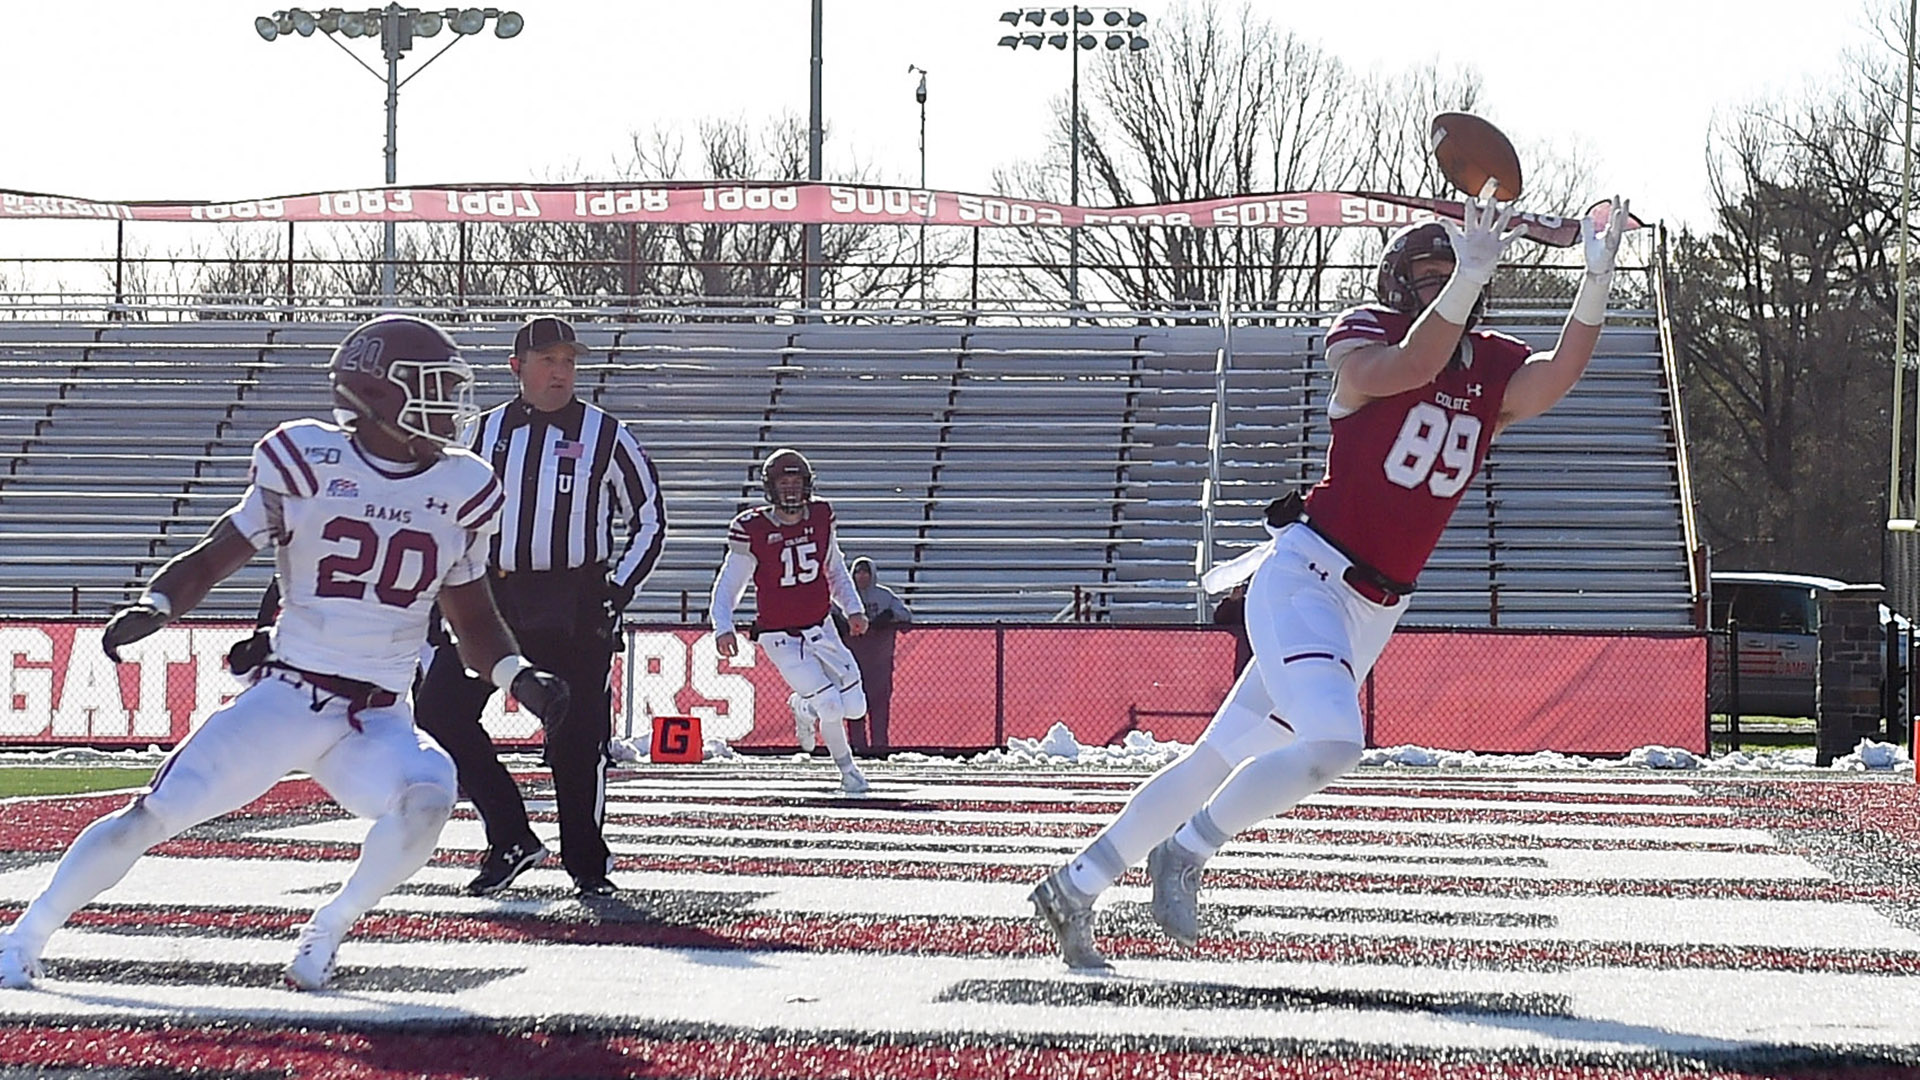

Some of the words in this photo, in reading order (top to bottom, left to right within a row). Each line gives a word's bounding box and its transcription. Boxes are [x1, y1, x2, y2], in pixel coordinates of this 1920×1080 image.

[342, 335, 384, 373] 20
[1384, 401, 1482, 498] 89
[558, 473, 573, 493] U
[364, 504, 412, 524] RAMS
[316, 516, 438, 608] 20
[781, 542, 819, 587] 15
[660, 719, 689, 754] G
